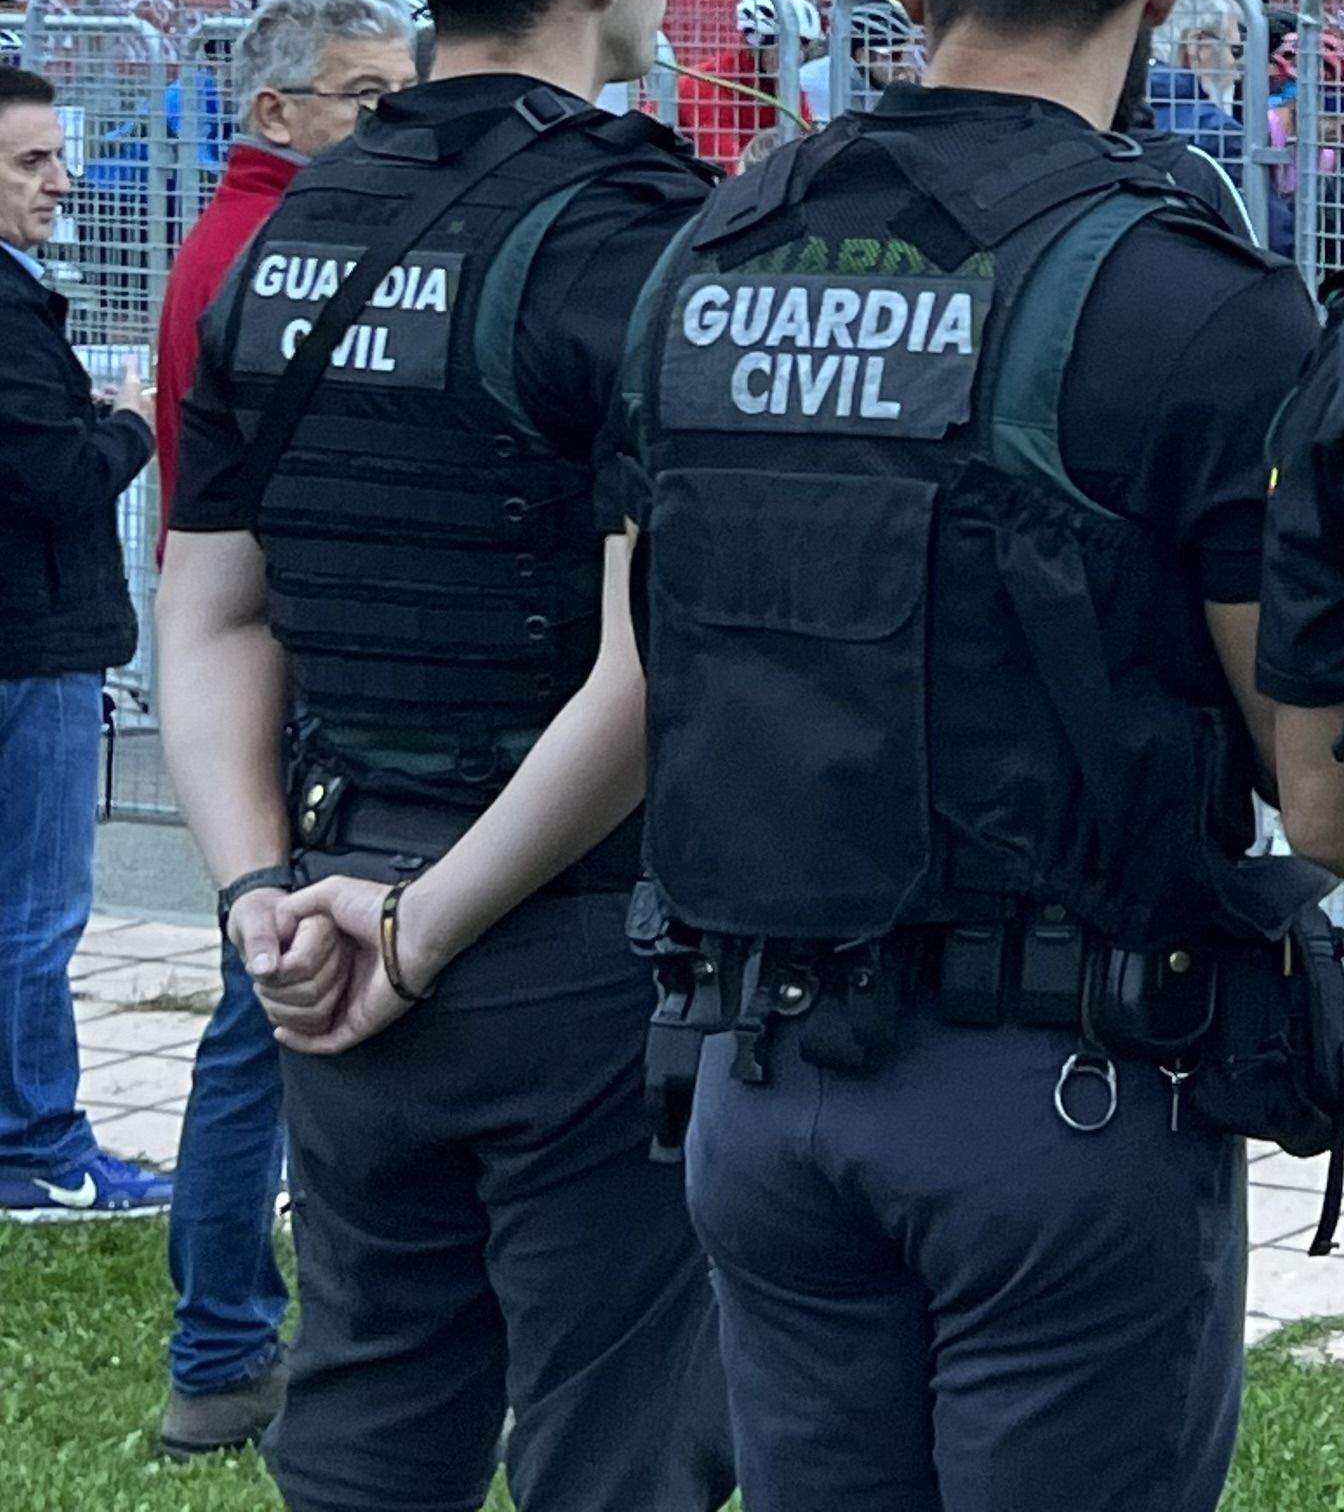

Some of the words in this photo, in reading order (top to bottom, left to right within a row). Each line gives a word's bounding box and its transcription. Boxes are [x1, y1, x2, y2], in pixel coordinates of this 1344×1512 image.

[254, 254, 449, 314] GUADIA
[281, 318, 397, 374] CVIL
[683, 284, 974, 356] GUARDIA
[731, 352, 903, 421] CIVIL
